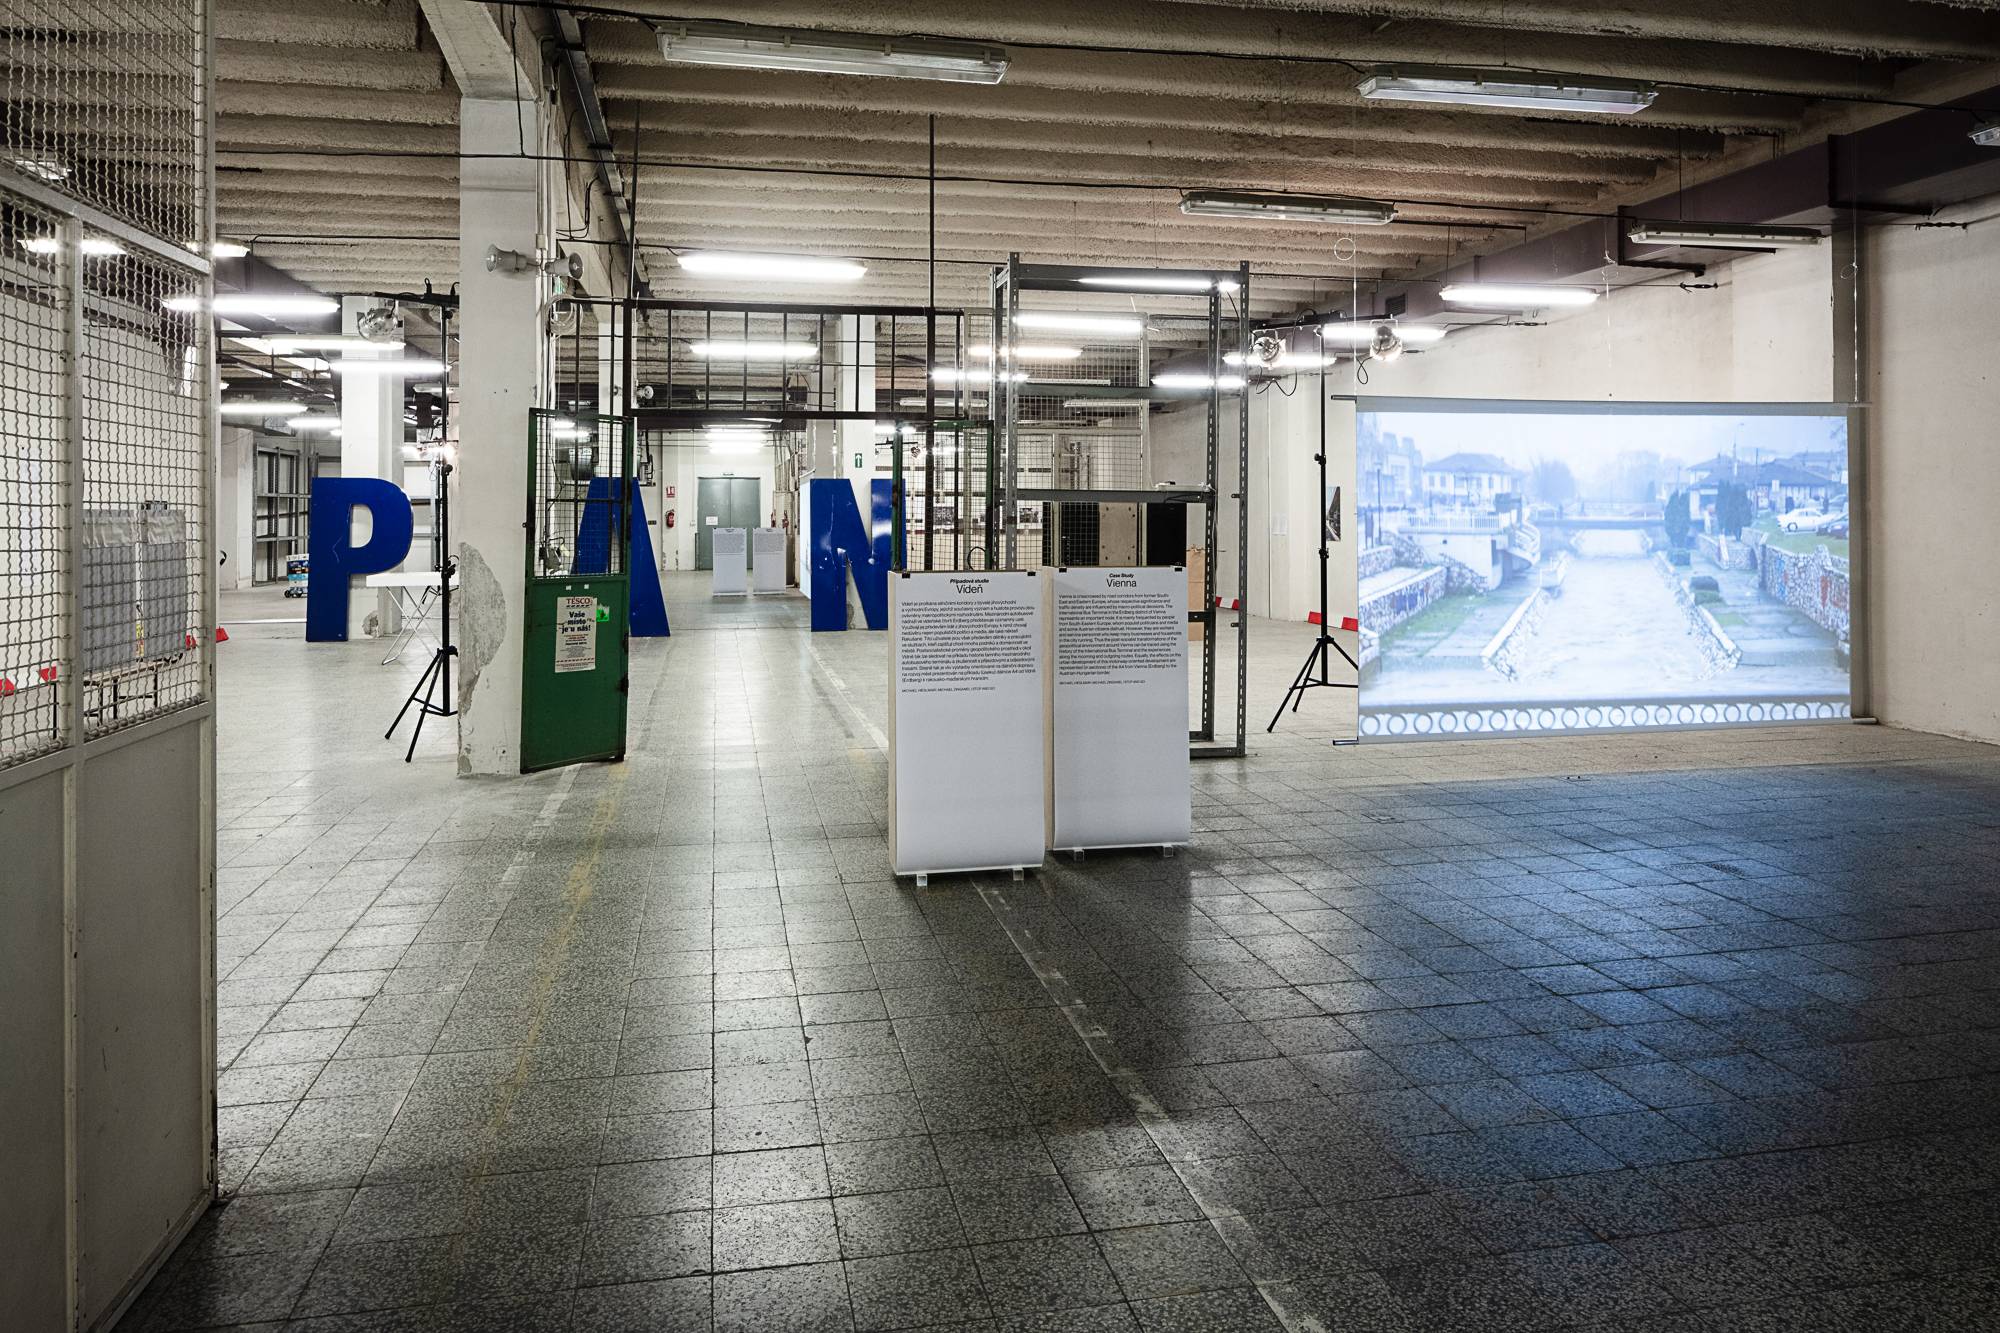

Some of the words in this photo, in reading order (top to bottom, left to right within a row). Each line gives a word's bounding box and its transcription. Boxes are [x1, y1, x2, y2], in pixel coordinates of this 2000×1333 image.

[306, 477, 414, 642] P
[570, 477, 670, 637] A
[810, 478, 907, 632] N
[1106, 578, 1136, 587] Vienna
